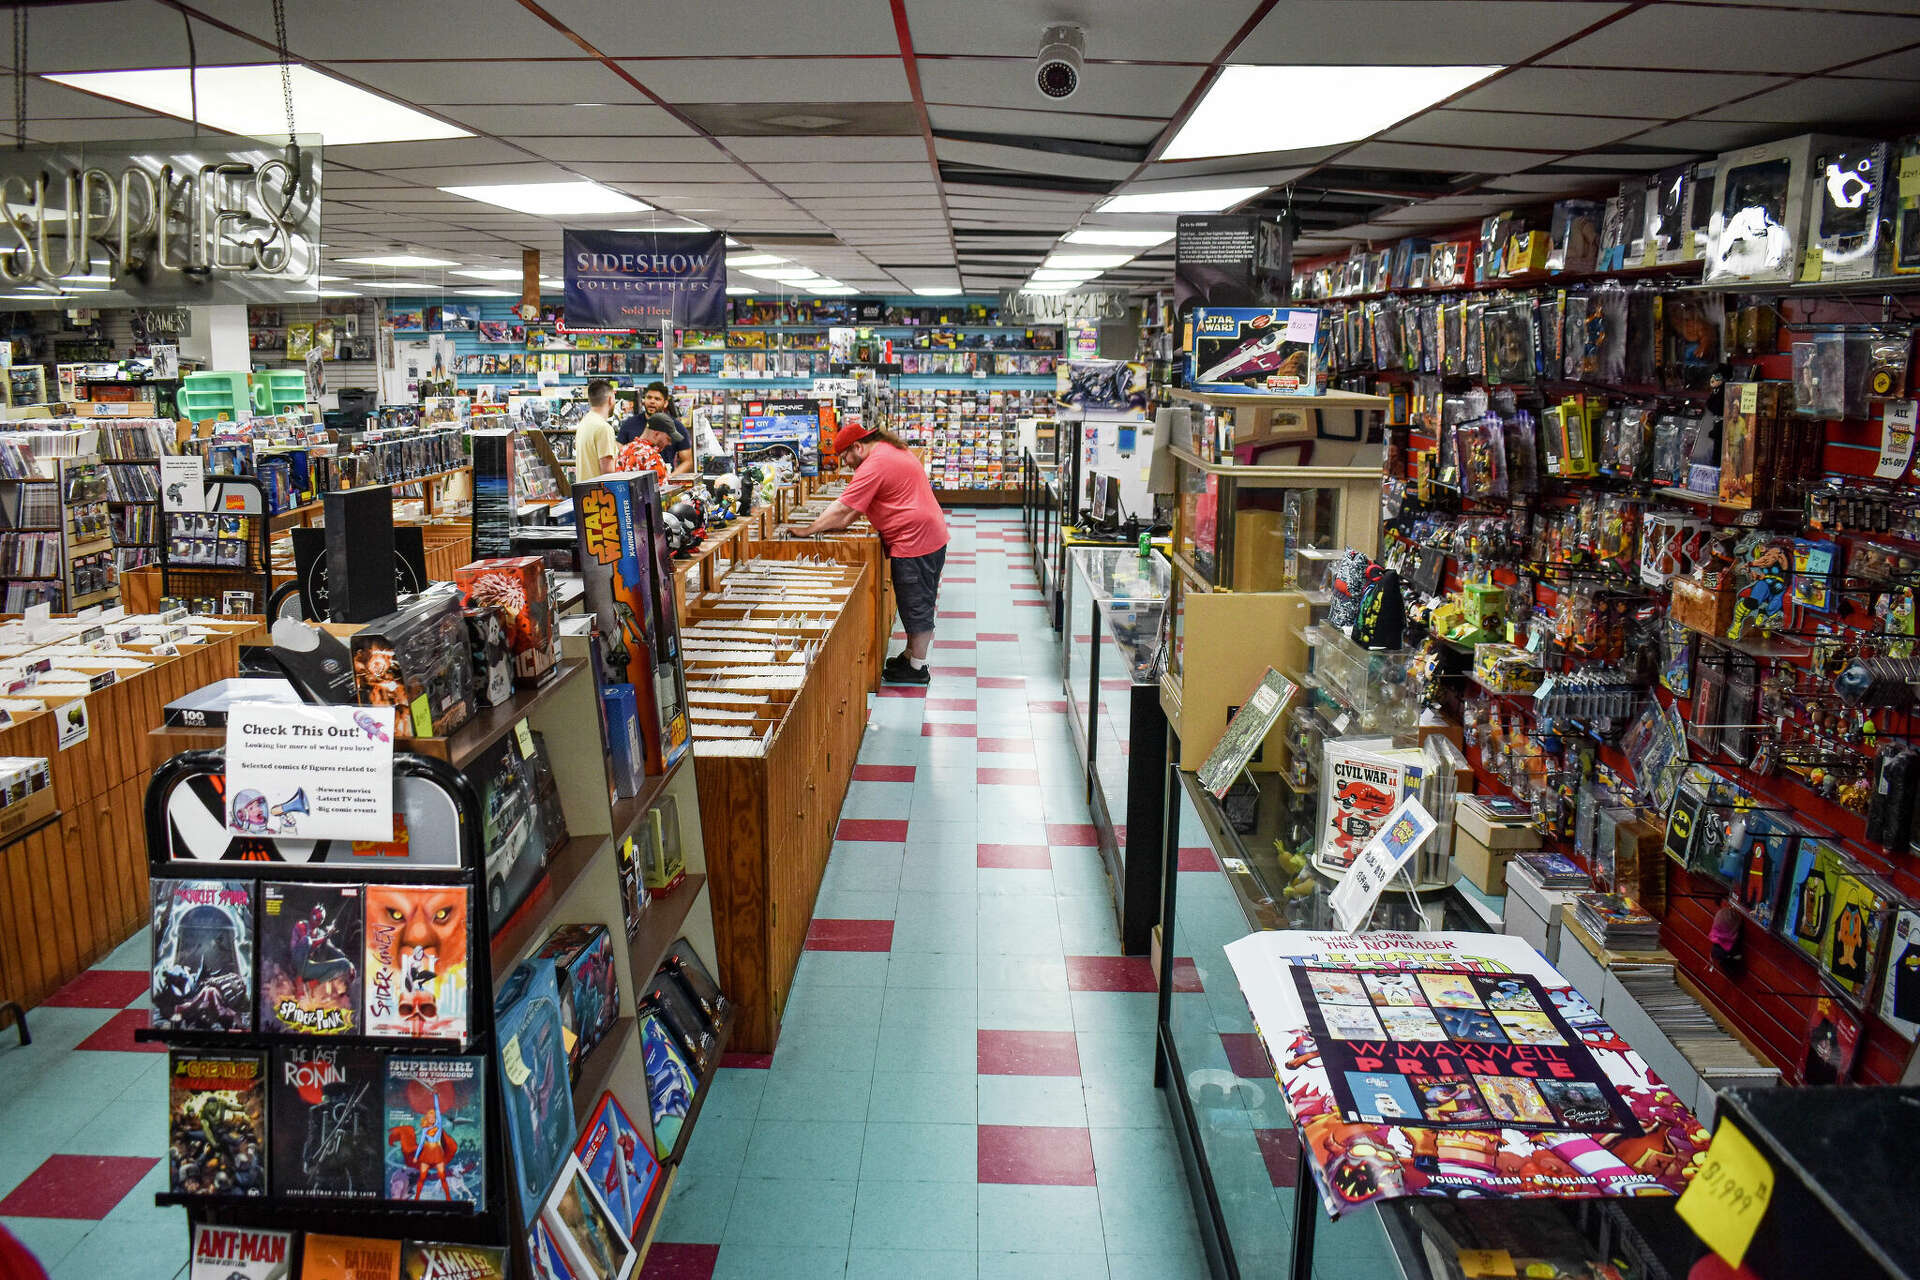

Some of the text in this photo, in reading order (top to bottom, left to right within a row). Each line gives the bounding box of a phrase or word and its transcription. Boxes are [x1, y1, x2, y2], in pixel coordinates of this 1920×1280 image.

[0, 158, 292, 282] SUPPLIES
[576, 252, 711, 273] SIDESHOW
[576, 280, 710, 292] COLLECTIBLES
[620, 305, 672, 316] Sold Here
[146, 310, 186, 334] GAMES
[1206, 315, 1234, 324] STAR
[1204, 323, 1235, 332] WARS
[1894, 409, 1909, 418] ALL
[1893, 458, 1908, 468] OFF
[583, 490, 603, 556] STAR
[599, 490, 623, 564] WARS
[623, 499, 637, 558] X-WING FIGHTER
[181, 710, 205, 720] 100
[243, 724, 360, 738] Check This Out!
[245, 742, 275, 750] Looking
[355, 744, 374, 752] love?
[309, 764, 336, 773] figures
[337, 765, 365, 773] related
[1334, 763, 1363, 780] CIVIL
[1363, 768, 1388, 785] WAR
[1330, 934, 1355, 942] HATE
[1359, 932, 1414, 942] RETURNS
[1324, 939, 1460, 951] THIS NOVEMBER
[1355, 952, 1455, 962] HATE
[279, 999, 345, 1031] SPIDER-PUNK
[291, 1049, 338, 1065] THE LAST
[187, 1061, 260, 1079] CREATURE
[389, 1060, 474, 1072] SUPERGIRL
[1354, 1056, 1576, 1079] PRINCE
[284, 1062, 347, 1089] RONIN
[1427, 1174, 1657, 1186] YOUNG BEAN BEAULIEU PIEKOS
[197, 1229, 287, 1263] ANT-MAN
[344, 1249, 393, 1270] BATMAN
